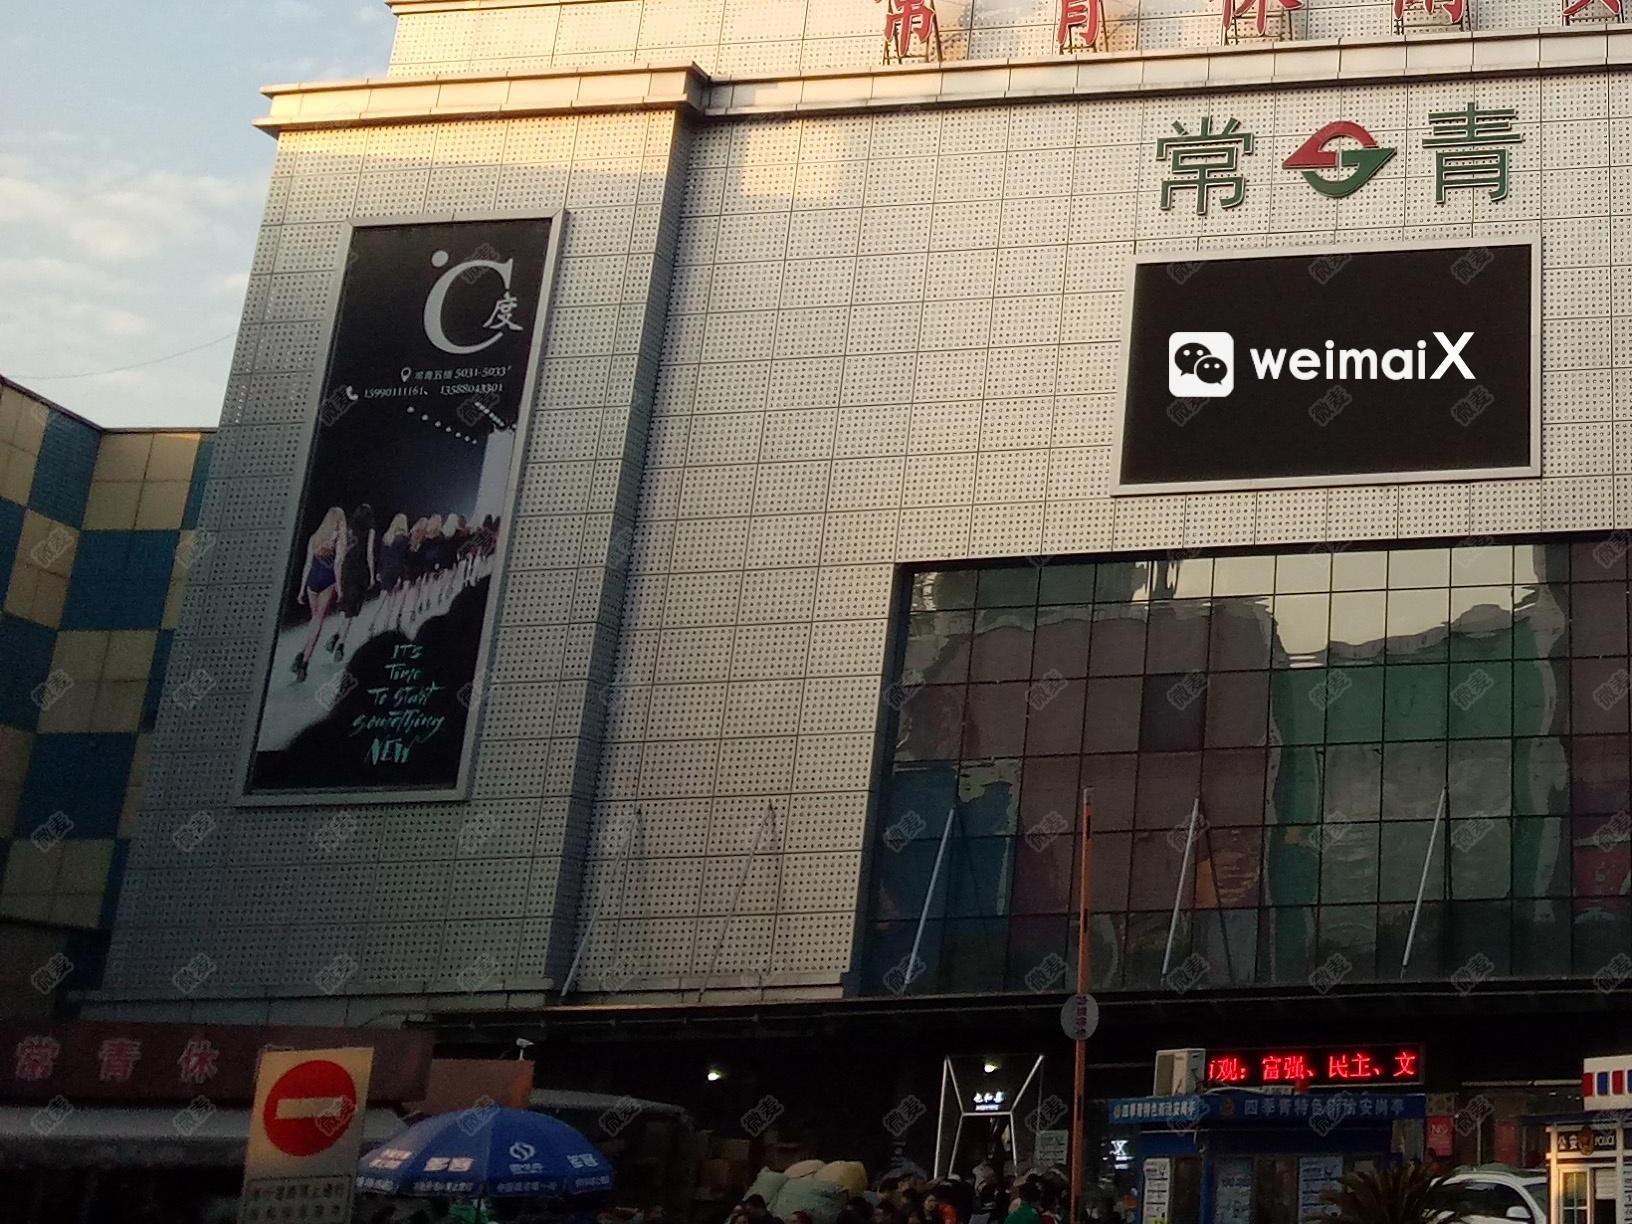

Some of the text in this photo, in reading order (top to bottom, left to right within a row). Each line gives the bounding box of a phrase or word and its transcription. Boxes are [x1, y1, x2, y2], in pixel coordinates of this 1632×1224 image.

[1156, 102, 1522, 214] 常青
[15, 1034, 296, 1084] 常青休
